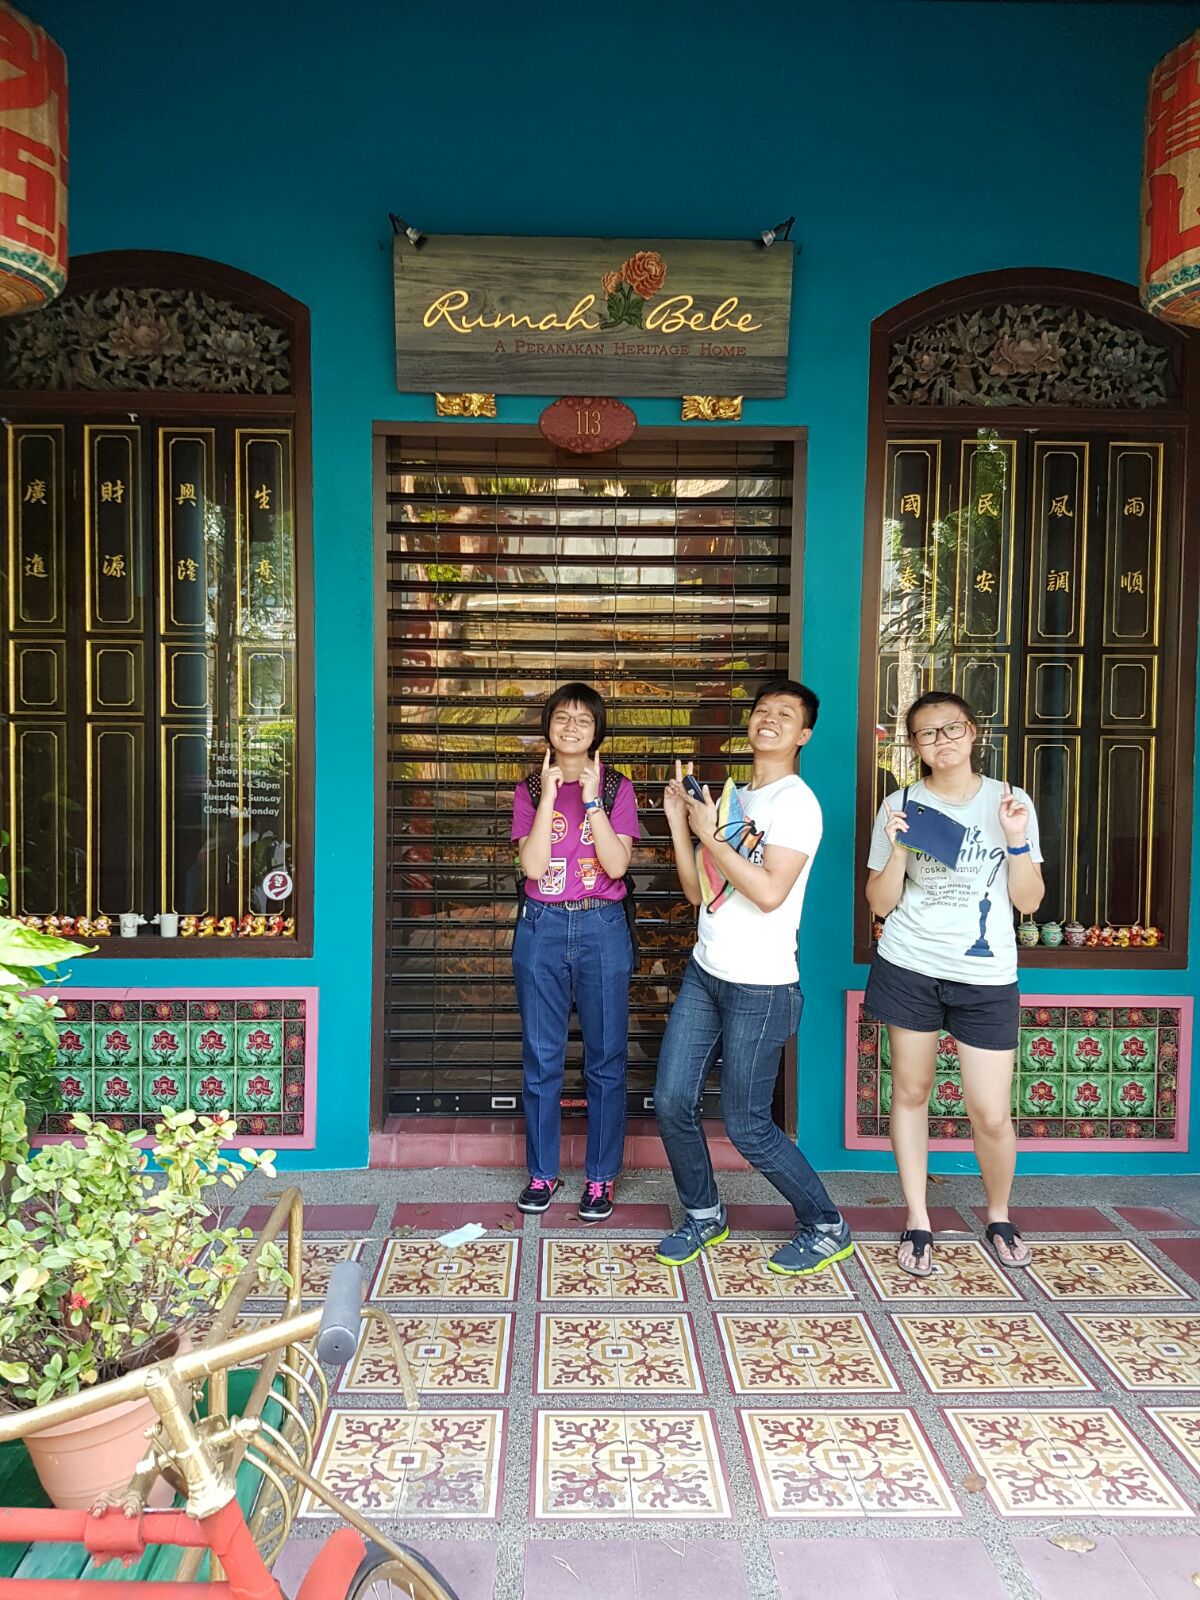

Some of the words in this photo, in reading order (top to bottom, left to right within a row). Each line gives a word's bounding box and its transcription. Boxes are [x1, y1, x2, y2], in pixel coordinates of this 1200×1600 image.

[422, 289, 600, 334] Rumah
[645, 294, 763, 334] Bebe
[495, 340, 506, 353] A
[515, 340, 605, 355] PERANAKAN
[613, 342, 690, 356] HERITAGE
[700, 342, 747, 356] HOME
[576, 410, 602, 436] 113
[216, 767, 238, 777] Shop
[203, 793, 239, 803] Tuesday
[248, 794, 281, 804] Sunday
[243, 806, 280, 817] Monday
